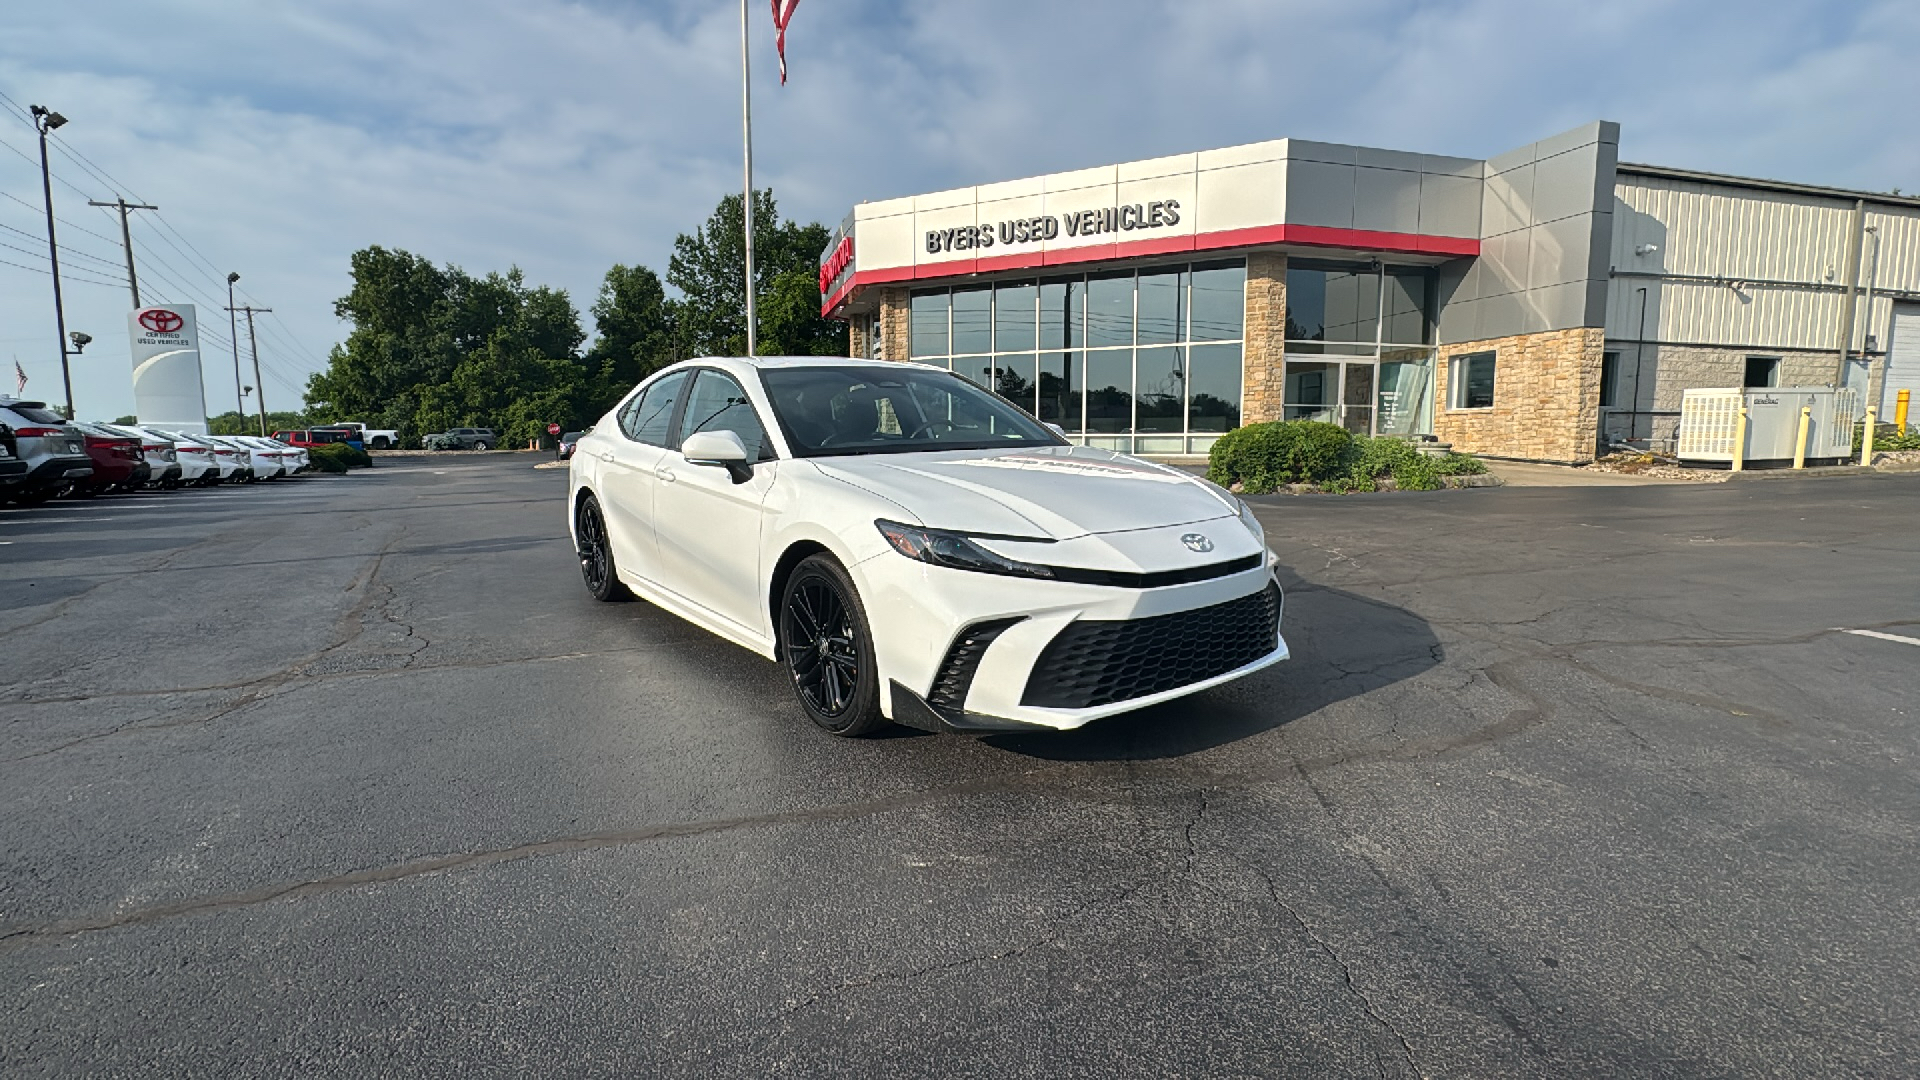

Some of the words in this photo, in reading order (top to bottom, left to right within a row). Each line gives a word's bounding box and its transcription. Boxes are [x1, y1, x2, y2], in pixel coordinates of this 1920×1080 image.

[926, 224, 994, 254] BYERS
[999, 215, 1058, 244] USED
[1063, 199, 1180, 237] VEHICLES
